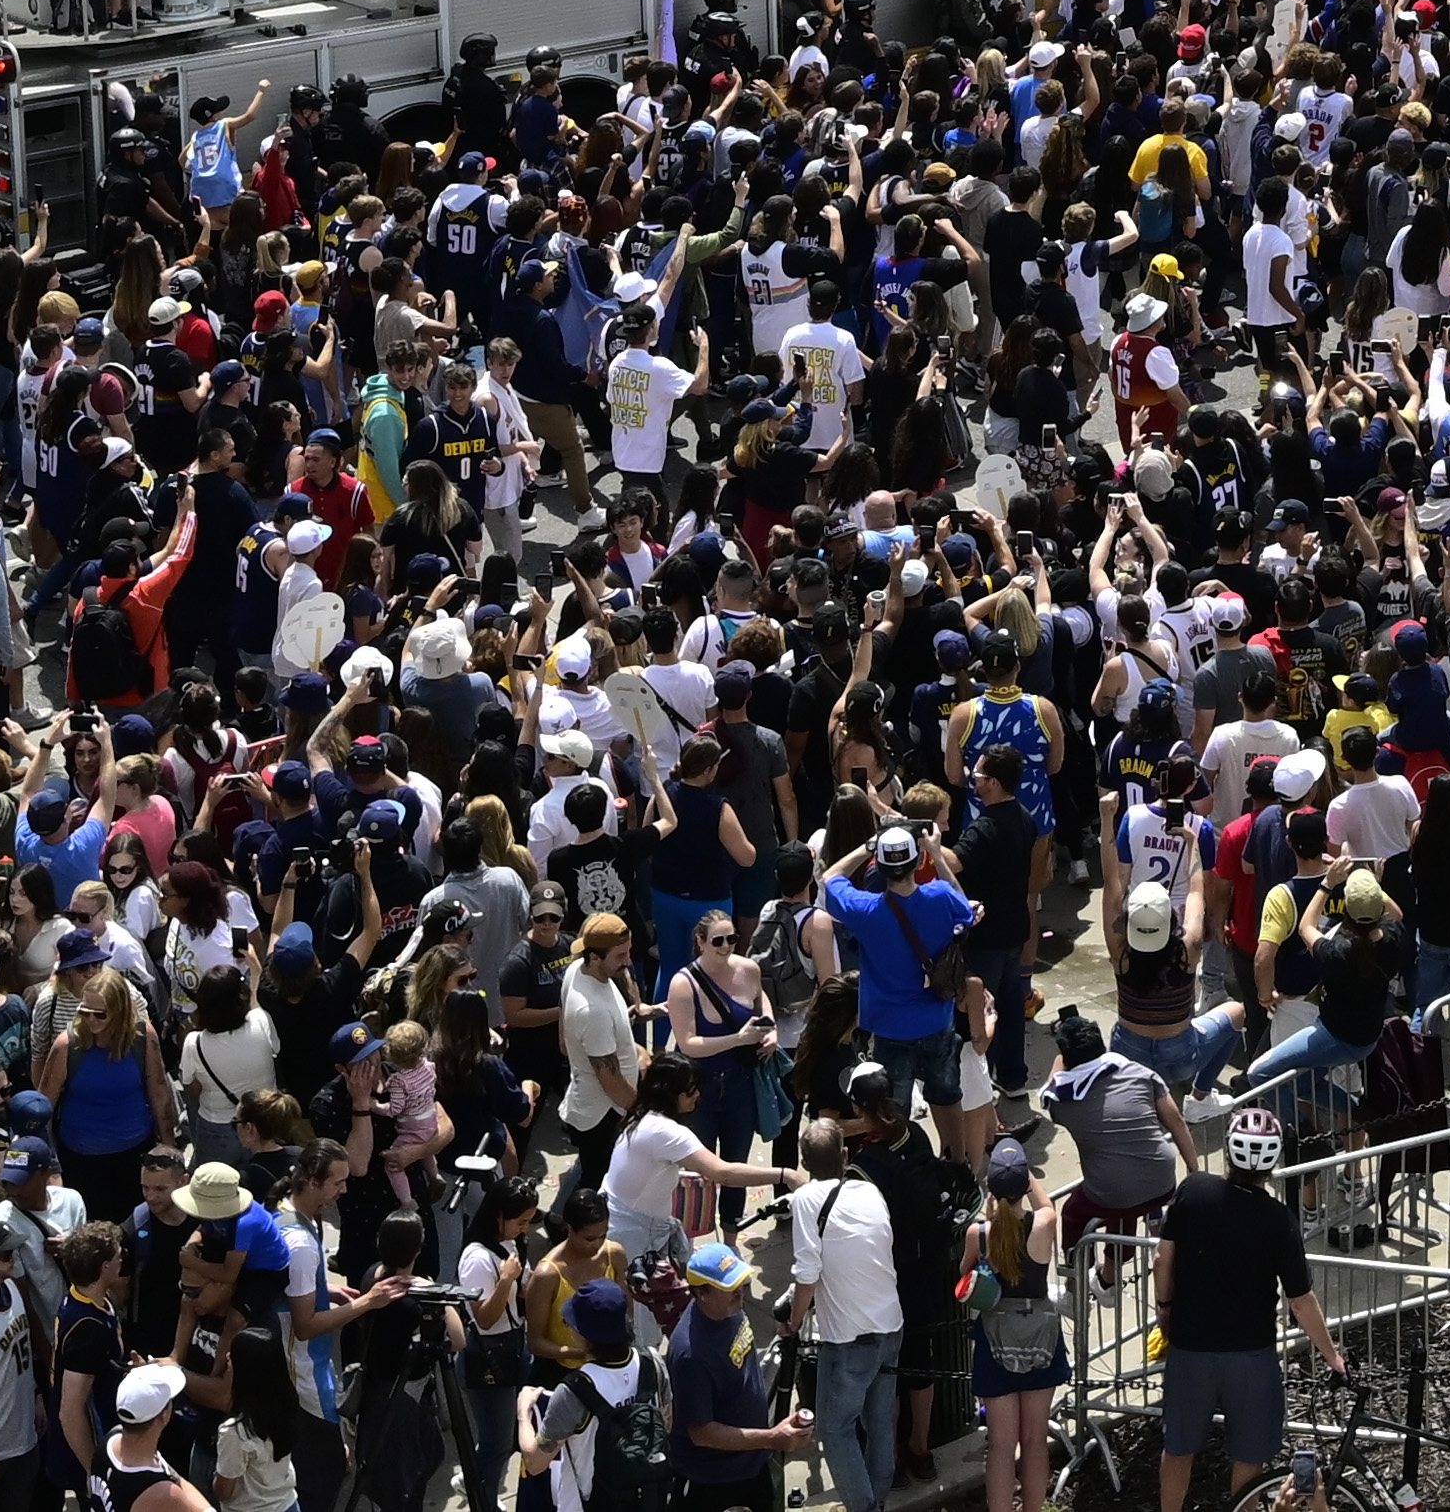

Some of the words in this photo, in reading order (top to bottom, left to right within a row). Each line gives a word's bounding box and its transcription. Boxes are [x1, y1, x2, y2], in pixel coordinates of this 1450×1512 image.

[1308, 123, 1325, 151] 2
[197, 145, 218, 170] 15
[447, 224, 476, 255] 50
[1353, 342, 1374, 374] 15
[1115, 364, 1131, 399] 15
[38, 440, 58, 476] 50
[444, 438, 485, 457] DENVER
[460, 457, 470, 480] 0
[1211, 478, 1239, 510] 27
[236, 554, 248, 593] 15
[1119, 757, 1152, 779] BRAUN
[1143, 835, 1179, 854] BRAUN
[1148, 856, 1170, 883] 2
[8, 1328, 31, 1377] 15
